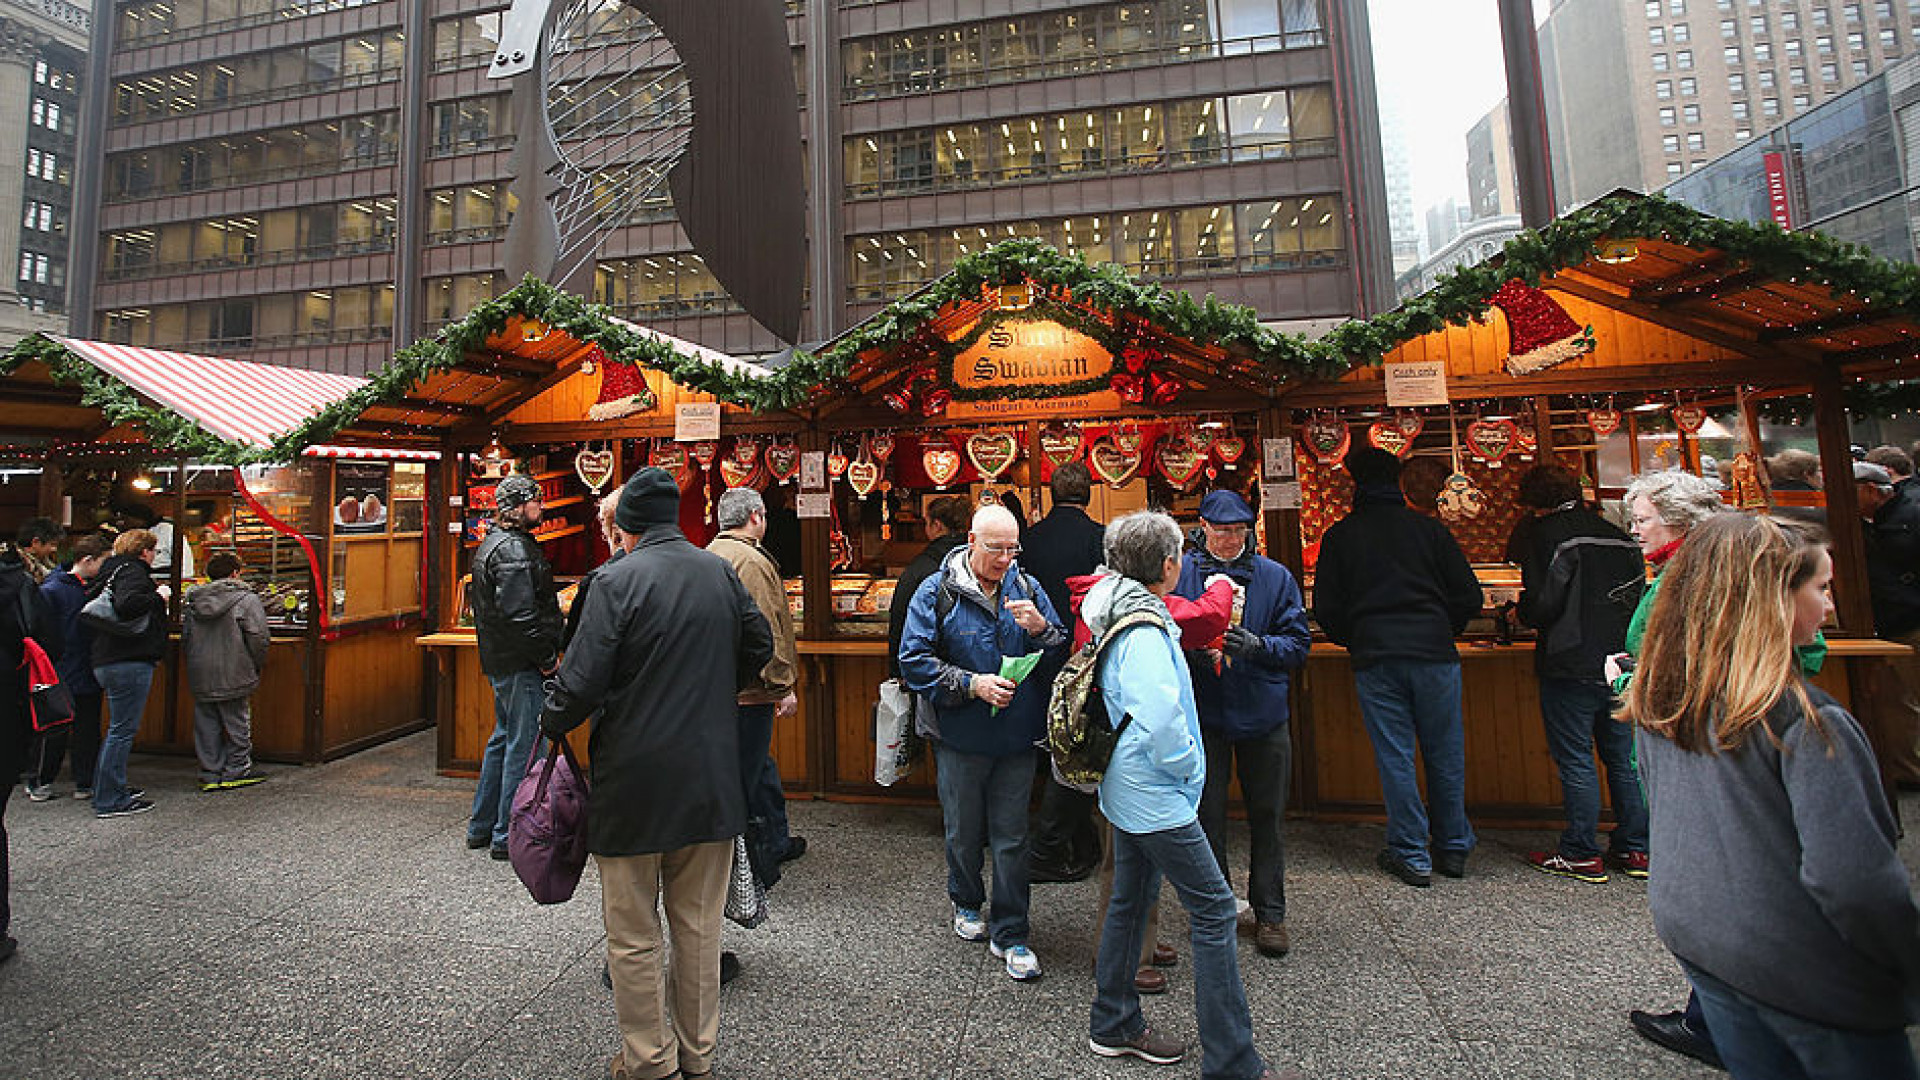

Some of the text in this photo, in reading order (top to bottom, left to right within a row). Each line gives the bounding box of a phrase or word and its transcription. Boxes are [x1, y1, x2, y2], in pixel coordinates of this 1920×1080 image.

[973, 356, 1088, 380] Swabian
[974, 401, 1023, 413] Stuttgart
[1034, 399, 1088, 410] Germany
